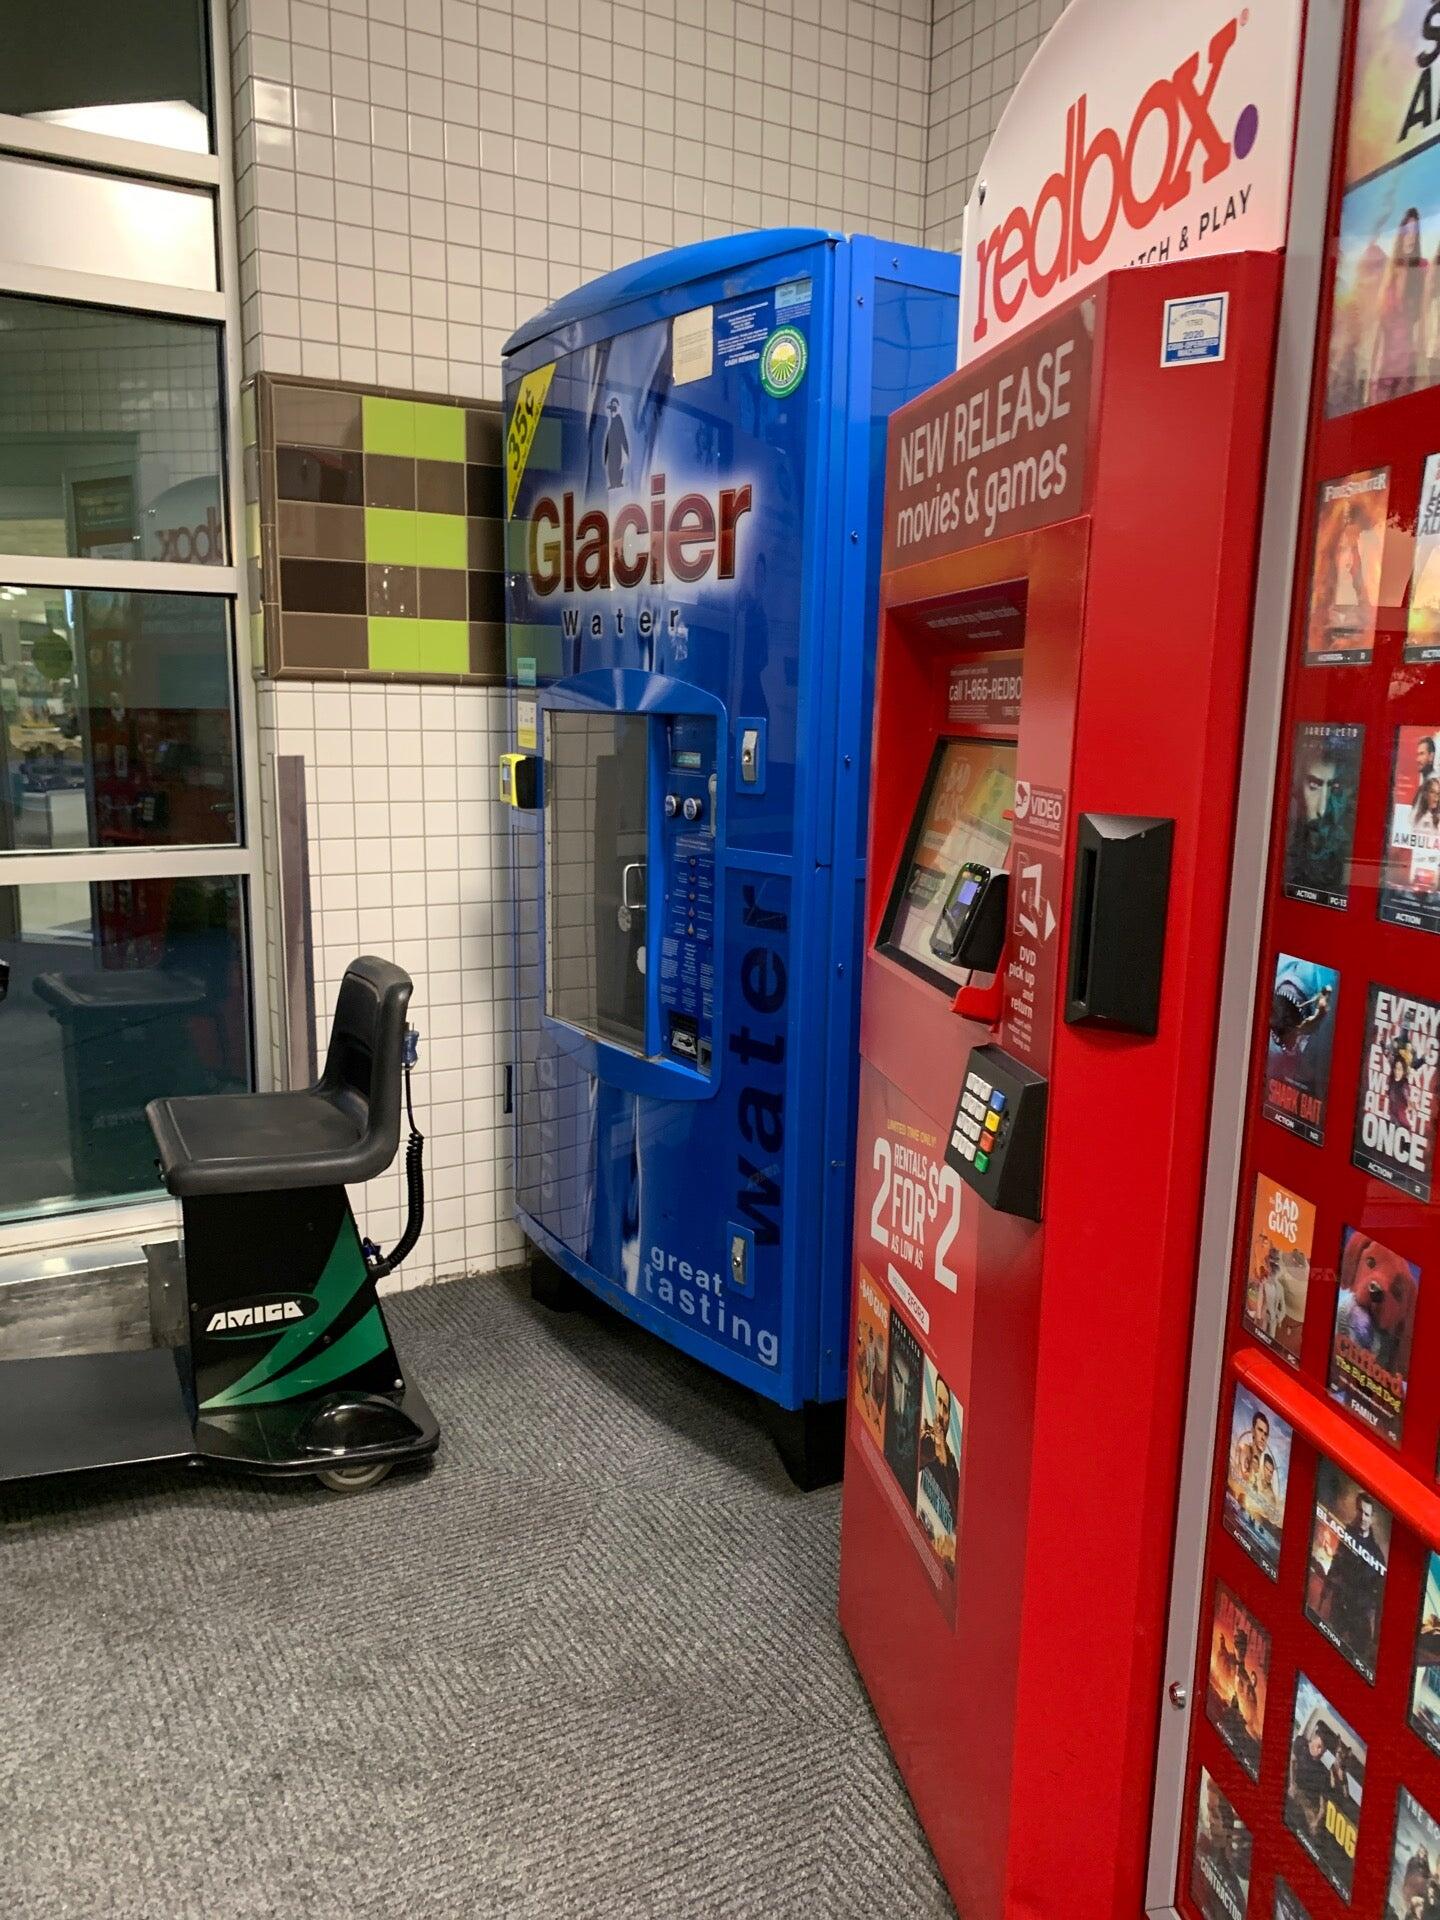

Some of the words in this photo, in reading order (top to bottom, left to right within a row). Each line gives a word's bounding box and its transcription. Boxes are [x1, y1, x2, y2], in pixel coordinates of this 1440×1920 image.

[1179, 225, 1189, 251] &
[1199, 184, 1252, 240] PLAY
[899, 412, 950, 491] NEW
[953, 339, 1075, 467] RELEASE
[897, 482, 961, 548] movies
[964, 466, 980, 525] &
[984, 442, 1069, 537] games
[529, 473, 753, 597] Glacier
[563, 607, 681, 637] Water
[949, 680, 963, 701] call
[964, 675, 1021, 701] 1-866-REDBO
[1031, 796, 1061, 820] VIDEO
[1393, 832, 1440, 850] AMBULA
[1296, 889, 1317, 900] ACTION
[1330, 896, 1347, 908] PG-13
[1395, 912, 1421, 925] ACTION
[1008, 961, 1024, 981] pick
[1019, 945, 1036, 967] DVD
[1374, 991, 1440, 1038] EVERY
[729, 885, 788, 1247] water
[1274, 1113, 1295, 1128] ACTION
[1363, 1090, 1392, 1122] ALL
[1361, 1112, 1429, 1173] ONCE
[893, 1143, 929, 1181] RENTALS
[1367, 1162, 1394, 1180] ACTION
[870, 1136, 893, 1248] 2
[1274, 1191, 1300, 1222] BAD
[891, 1172, 926, 1246] FOR
[1268, 1210, 1299, 1244] GUYS
[890, 1234, 900, 1256] AS
[900, 1239, 915, 1265] LOW
[914, 1247, 925, 1271] AS
[650, 1246, 723, 1297] great
[206, 1301, 304, 1332] AMIGO
[643, 1263, 779, 1367] tasting
[1351, 1398, 1379, 1427] FAMILY
[1315, 1506, 1388, 1578] BLACKLIGHT
[1318, 1620, 1342, 1648] ACTION
[1355, 1657, 1375, 1682] PG-13
[1325, 1799, 1358, 1859] DOG
